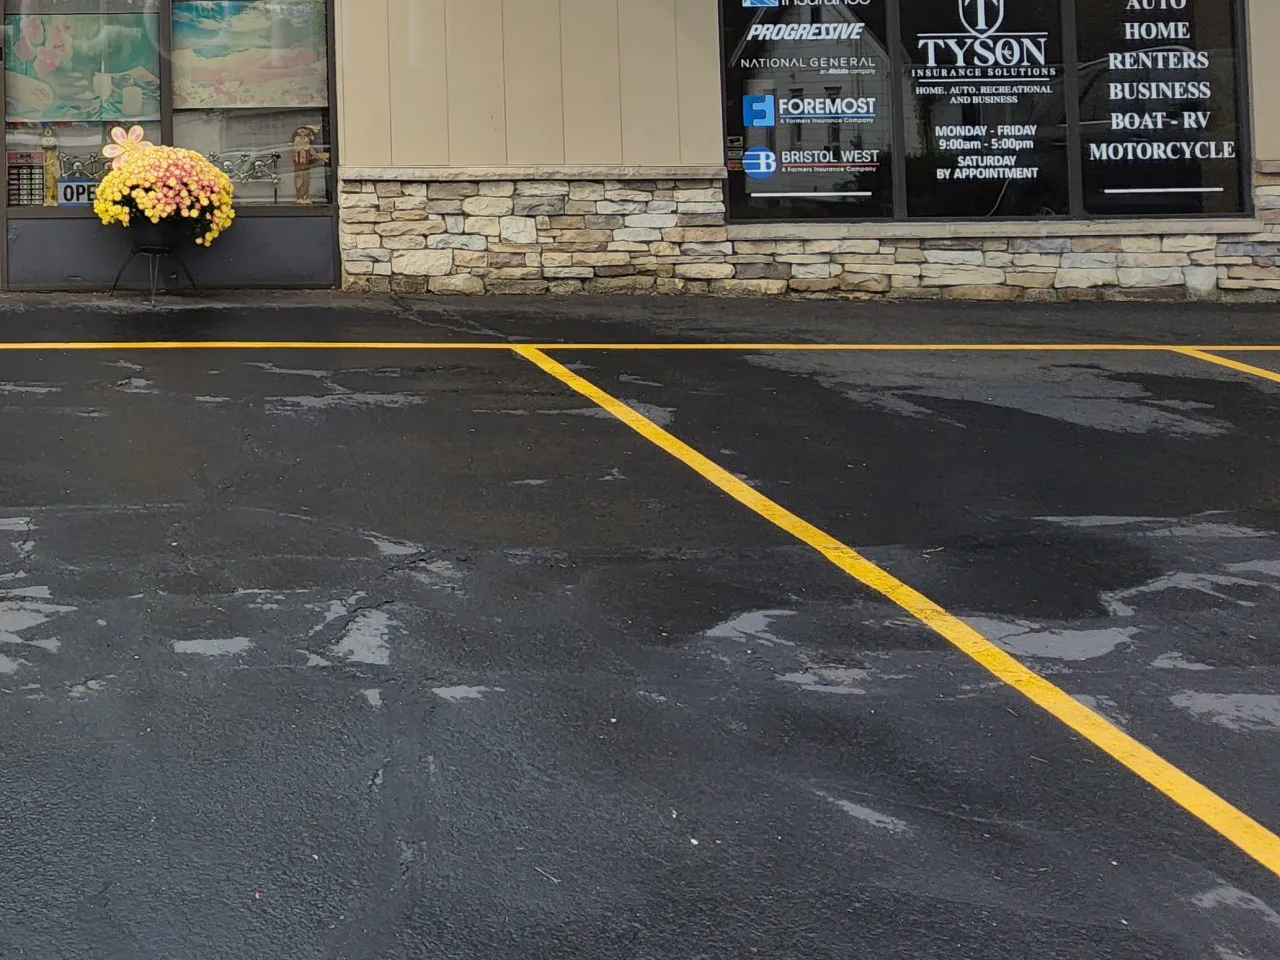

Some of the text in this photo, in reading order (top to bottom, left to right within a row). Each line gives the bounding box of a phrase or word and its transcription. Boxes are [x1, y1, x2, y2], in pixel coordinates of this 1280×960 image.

[747, 22, 866, 41] PROGRESSIVE
[1123, 22, 1191, 40] HOME
[918, 38, 1048, 67] TYSON
[741, 57, 876, 68] NATIONAL GENERAL
[1108, 51, 1210, 70] RENTERS
[850, 68, 876, 76] company
[911, 67, 1056, 77] INSURANCE SOLUTIONS
[980, 85, 1053, 94] RECREATIONAL
[1108, 82, 1211, 100] BUSINESS
[778, 97, 876, 114] FOREMOST
[949, 95, 1018, 104] AND BUSINESS
[844, 117, 874, 125] Company
[1110, 112, 1166, 130] BOAT
[1183, 111, 1211, 129] RV
[935, 125, 988, 137] MONDAY
[997, 125, 1037, 136] FRIDAY
[939, 139, 982, 150] 9:00am
[991, 138, 1034, 151] 5:00pm
[1089, 141, 1236, 161] MOTORCYCLE
[781, 149, 880, 163] BRISTOL WEST
[957, 155, 1017, 167] SATURDAY
[936, 167, 1039, 179] BY APPOINTMENT
[62, 184, 98, 202] OPE
